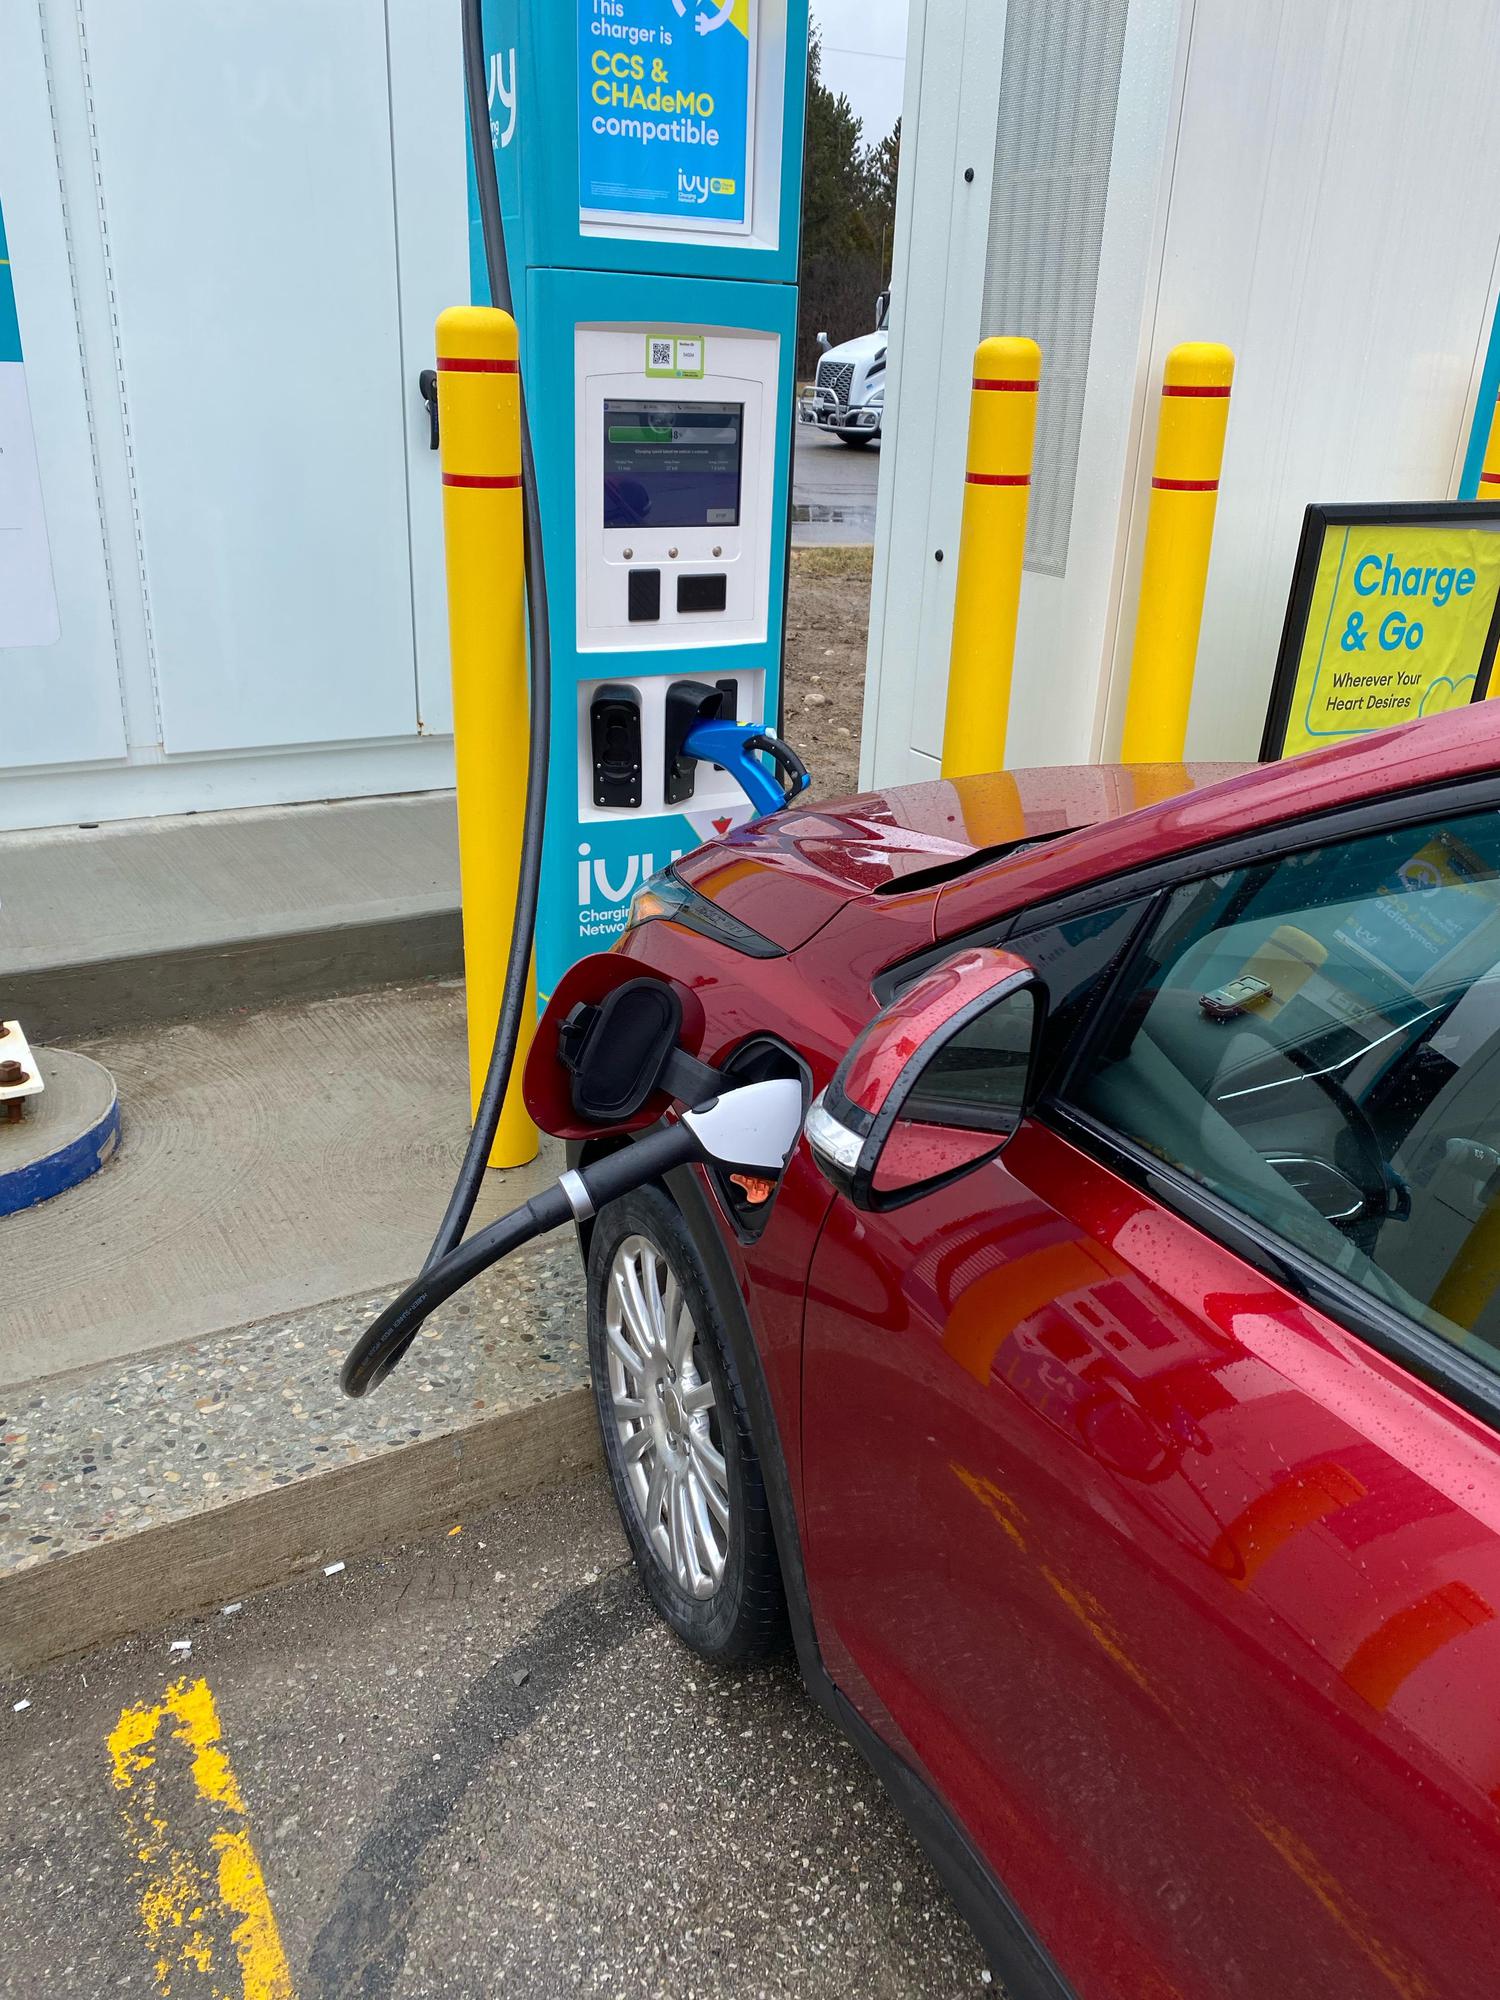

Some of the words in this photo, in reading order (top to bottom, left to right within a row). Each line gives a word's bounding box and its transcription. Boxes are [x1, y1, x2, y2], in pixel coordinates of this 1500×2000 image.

[592, 0, 624, 18] This
[591, 17, 656, 45] charger
[660, 26, 673, 45] is
[591, 49, 644, 80] CCS
[651, 58, 668, 83] &
[591, 80, 714, 117] CHAdeMO
[591, 116, 720, 147] compatible
[678, 168, 709, 204] ivy
[1354, 553, 1476, 607] Charge
[1340, 611, 1368, 652] &
[1379, 611, 1424, 651] Go
[1333, 672, 1393, 688] Wherever
[1396, 671, 1422, 686] Your
[1326, 696, 1365, 711] Heart
[1367, 694, 1411, 710] Desires
